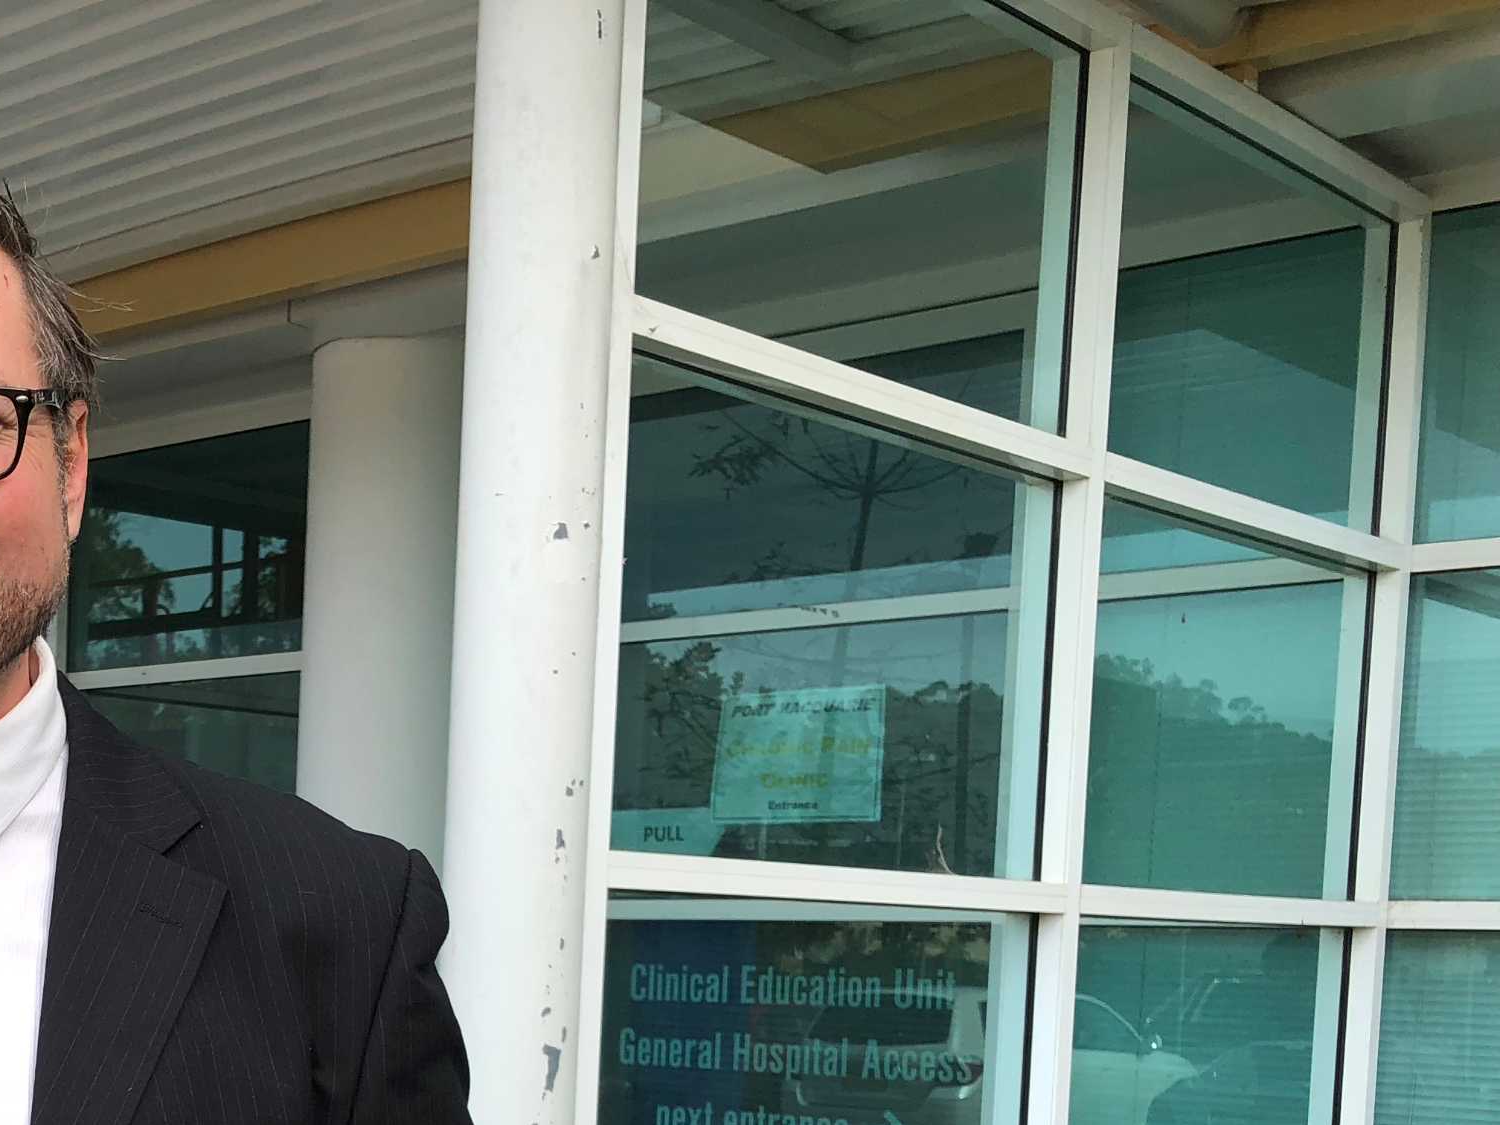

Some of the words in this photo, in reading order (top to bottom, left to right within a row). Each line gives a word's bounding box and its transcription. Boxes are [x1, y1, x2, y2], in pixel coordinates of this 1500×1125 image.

[643, 825, 684, 842] PULL
[630, 962, 729, 1004] Clinical
[740, 965, 881, 1008] Education
[894, 968, 956, 1009] Unit
[619, 1027, 722, 1071] General
[732, 1032, 849, 1080] Hospital
[861, 1039, 973, 1083] Access
